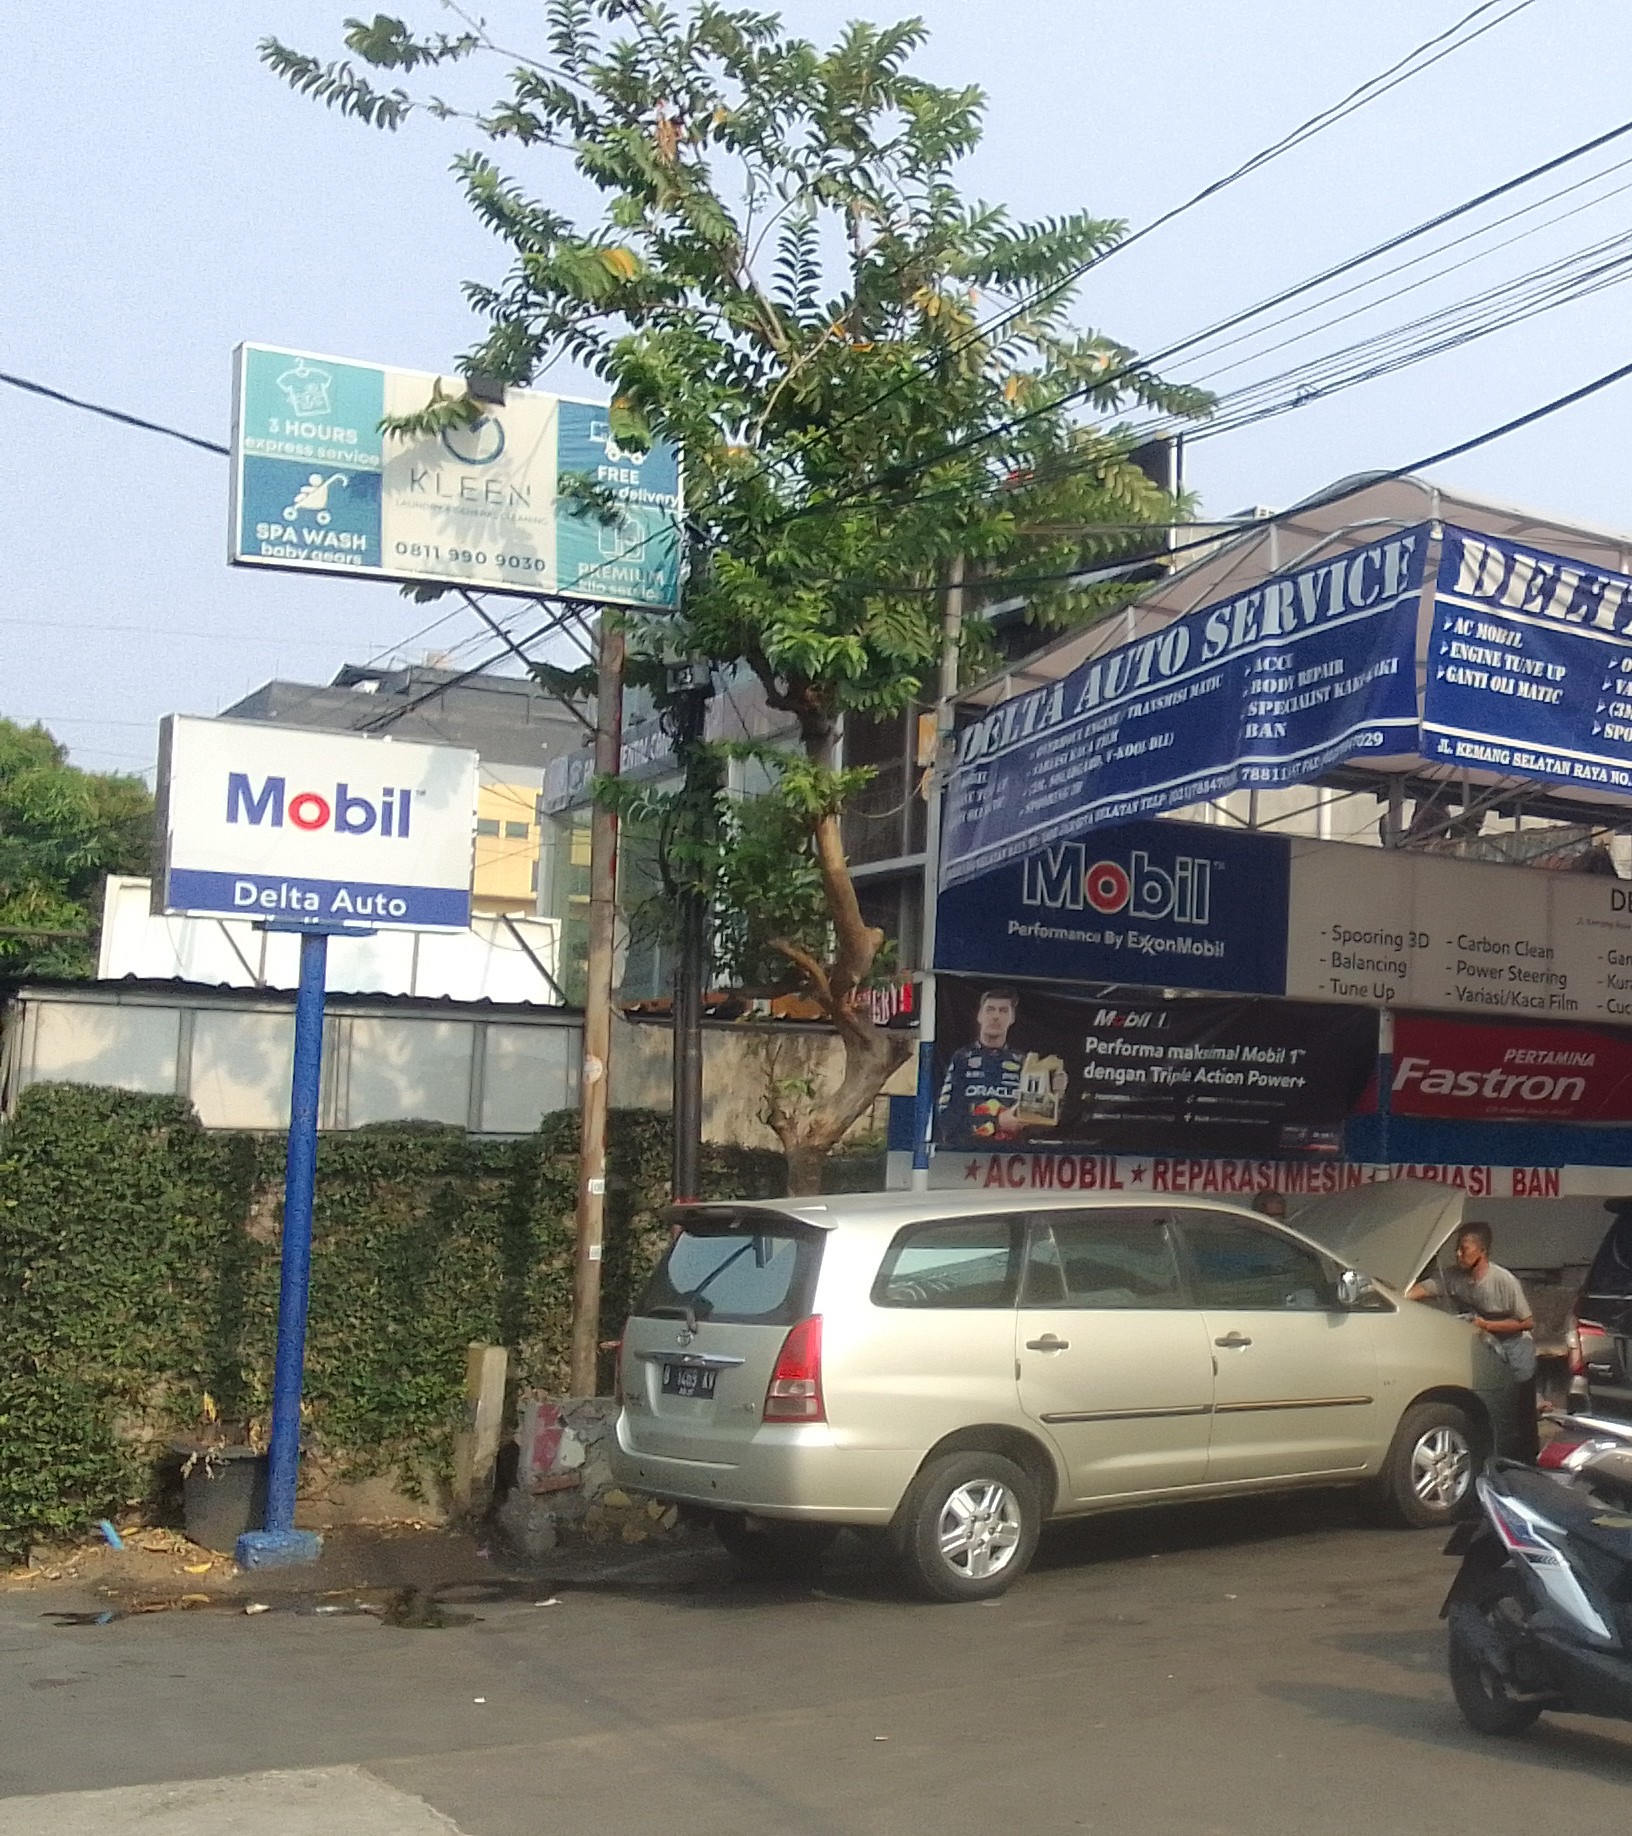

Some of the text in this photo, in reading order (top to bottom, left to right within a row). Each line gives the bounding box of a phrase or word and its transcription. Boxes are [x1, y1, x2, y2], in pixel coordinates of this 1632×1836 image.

[268, 417, 358, 446] 3 HOURS
[245, 437, 380, 466] express service
[409, 467, 532, 508] KLEEN
[597, 465, 640, 485] FREE
[618, 486, 679, 508] delivery
[256, 522, 367, 551] SPA WASH
[261, 542, 309, 560] baby
[394, 541, 440, 559] 0811
[448, 548, 488, 565] 990
[495, 554, 547, 572] 9030
[1453, 617, 1524, 649] AC MOBIL
[955, 536, 1416, 767] DELTA AUTO SERVICE
[1450, 641, 1567, 682] ENGINE TUNE UP
[1251, 675, 1294, 696] BODY
[1446, 665, 1563, 706] GANTI OLI MATIC
[1247, 685, 1332, 717] SPECIALIST
[1245, 721, 1287, 740] BAN
[1437, 738, 1454, 755] JL.
[1455, 742, 1510, 766] KEMANG
[1512, 753, 1571, 777] SELATAN
[1573, 764, 1608, 784] RAYA
[226, 772, 412, 839] Mobil
[1022, 841, 1211, 925] Mobil
[233, 880, 408, 917] Delta Auto
[1008, 920, 1225, 958] Performance By ExxonMobil
[1331, 925, 1430, 952] Spooring 3D
[1457, 933, 1554, 960] Carbon Clean
[1331, 952, 1408, 978] Balancing
[1456, 959, 1568, 990] Power Steering
[1329, 978, 1396, 1003] Tune Up
[1455, 984, 1579, 1012] Variasi/Kaca Film
[1093, 1008, 1150, 1029] Mobil
[1085, 1036, 1164, 1060] Performa
[1168, 1042, 1239, 1064] maksimal
[1242, 1045, 1286, 1065] Mobil
[1503, 1048, 1596, 1068] PERTAMINA
[1083, 1062, 1306, 1090] dengan Triple Action Power+
[1392, 1056, 1586, 1102] Fastron
[982, 1153, 1124, 1191] AC MOBIL
[1152, 1157, 1363, 1195] REPARASI MESIN
[1511, 1167, 1560, 1198] BAN
